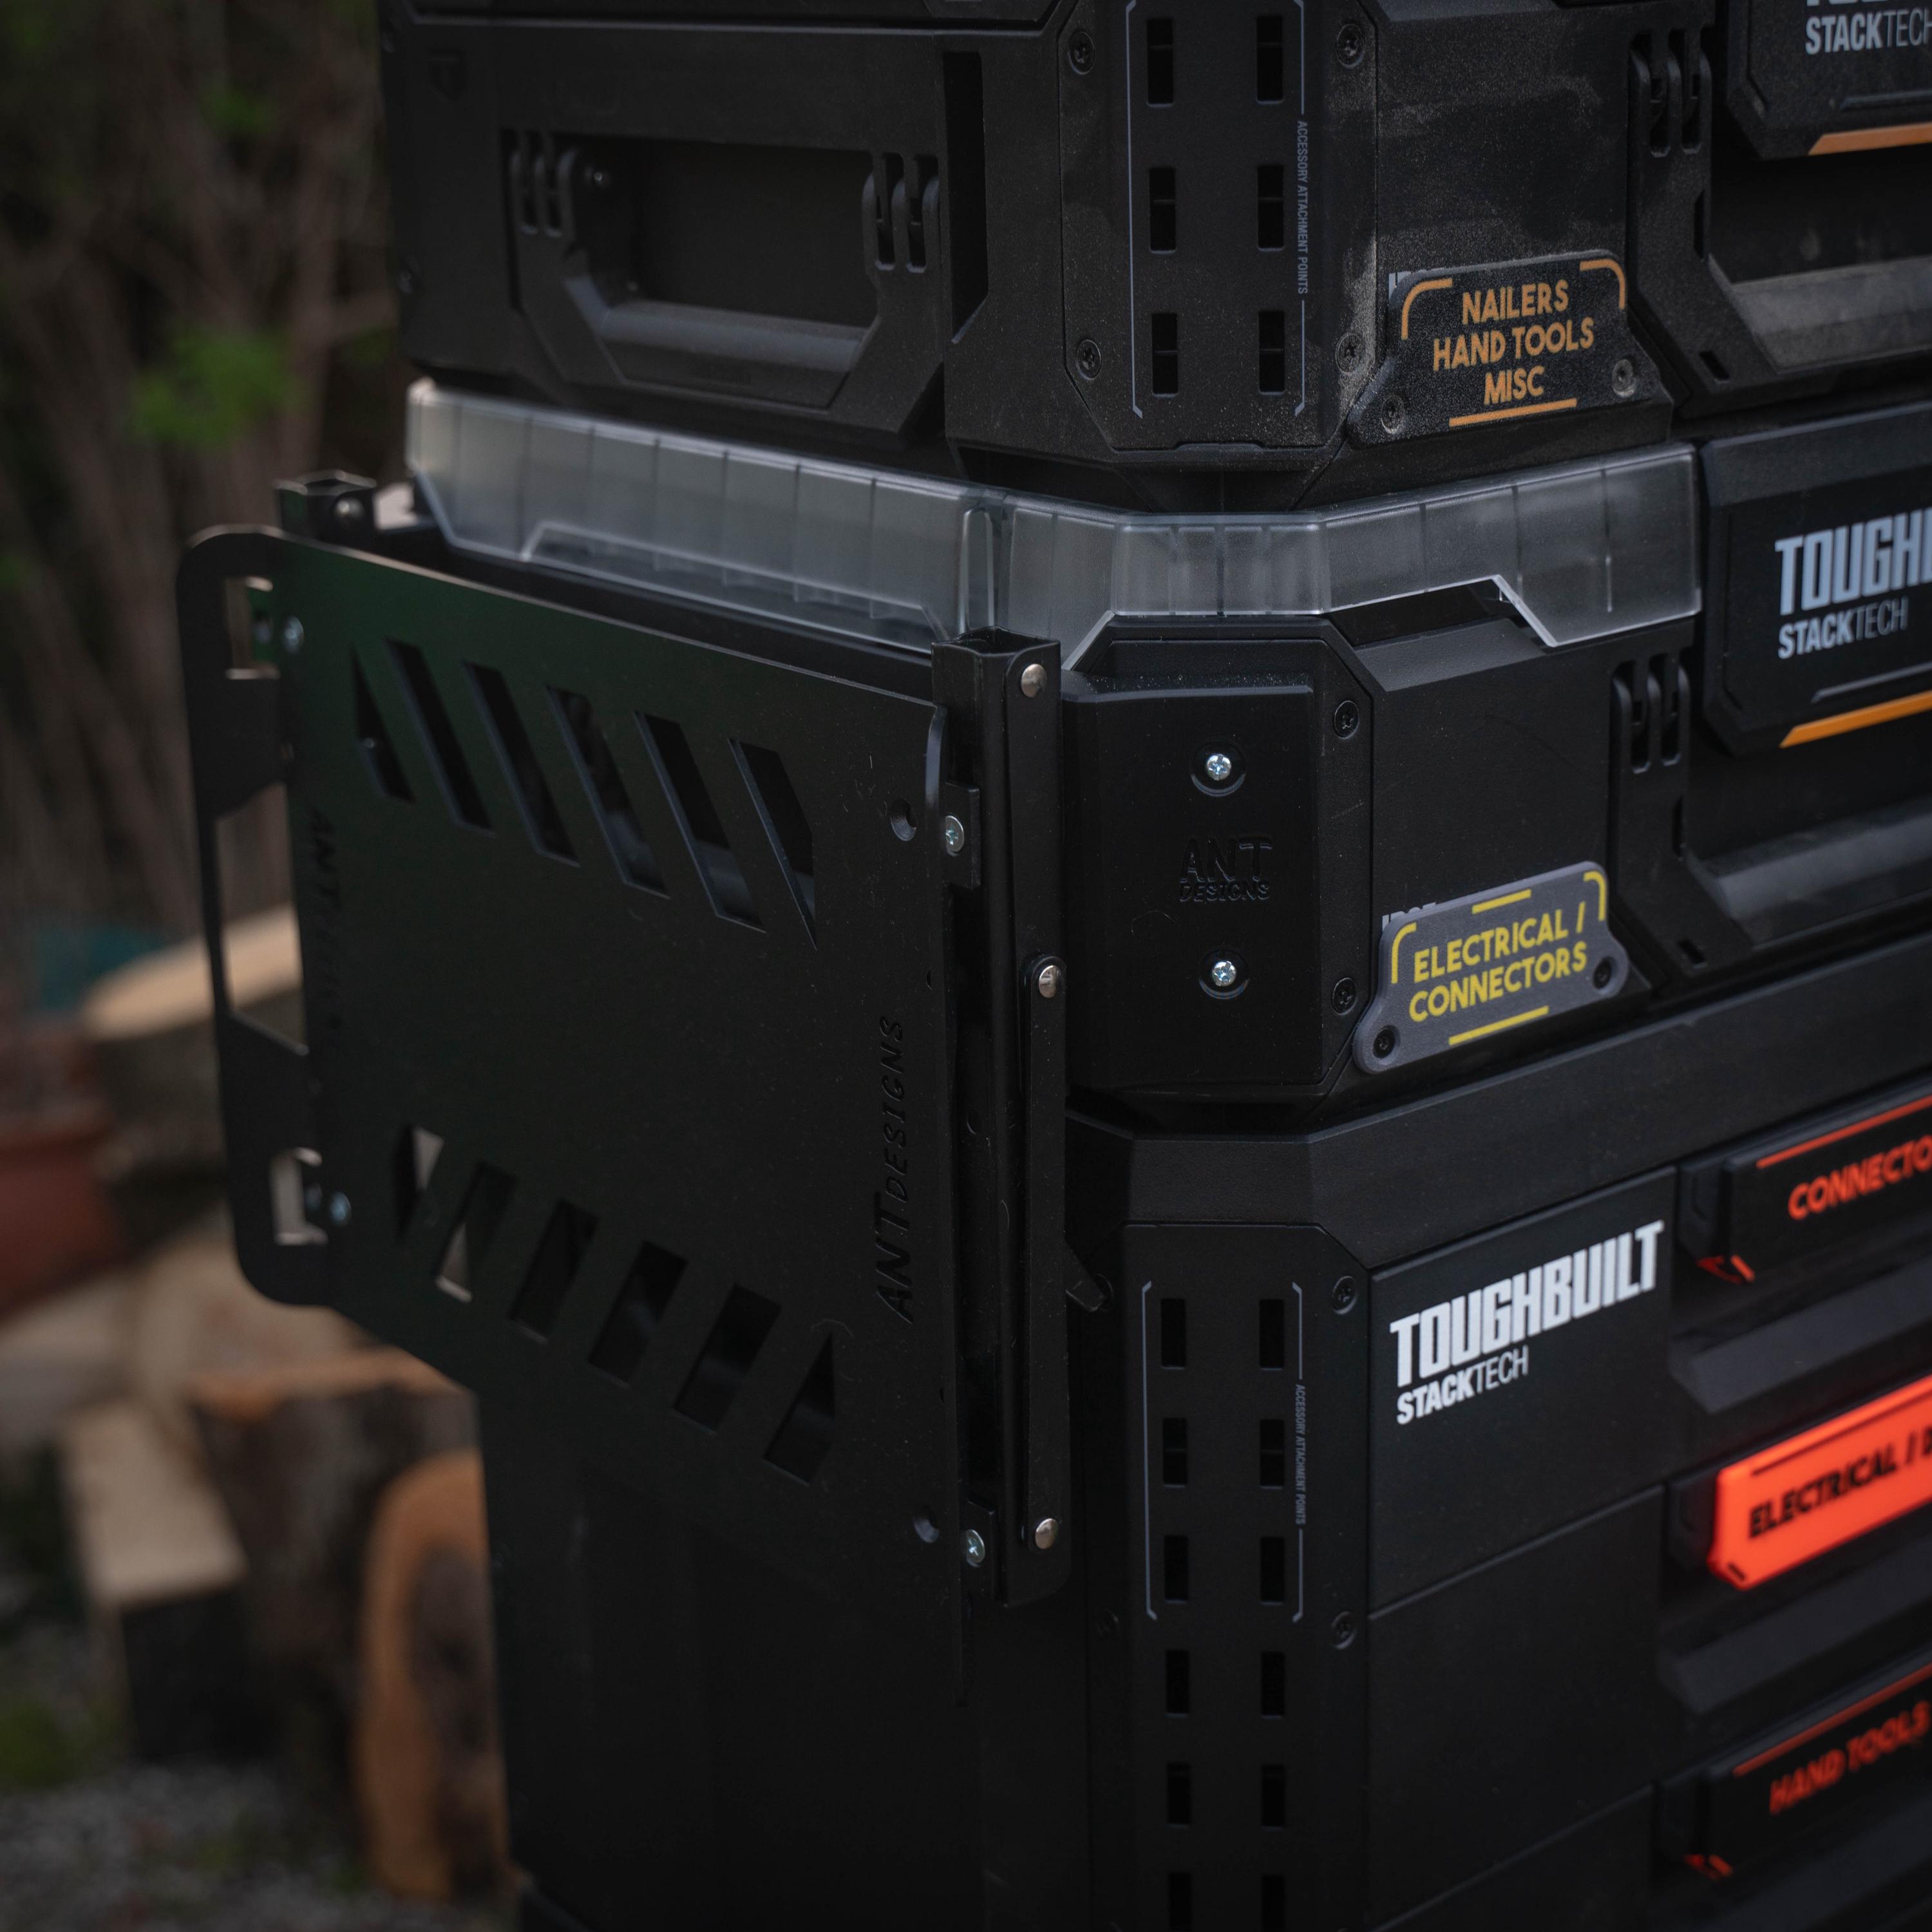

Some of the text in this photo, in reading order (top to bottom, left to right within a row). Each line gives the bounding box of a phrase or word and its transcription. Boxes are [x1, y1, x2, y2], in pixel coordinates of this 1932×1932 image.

[1805, 7, 1932, 55] STACKTECH
[1297, 120, 1308, 294] ACCESSORY ATTACHMENT POINTS
[1462, 279, 1569, 325] NAILERS
[1433, 316, 1595, 371] HAND TOOLS
[1483, 365, 1546, 406] MISC
[1777, 595, 1909, 659] STACKTECH
[1180, 837, 1273, 883] ANT
[1180, 880, 1270, 902] DESIGNS
[1408, 940, 1587, 1023] CONNECTORS
[1414, 909, 1568, 983] ELECTRICAL
[1576, 900, 1586, 934] /
[1389, 1220, 1665, 1388] TOUGHBUILT
[1396, 1345, 1530, 1425] STACKTECH
[1295, 1384, 1306, 1526] ACCESSORY ATTACHMENT POINTS
[1749, 1442, 1897, 1539] ELECTRICAL
[1769, 1700, 1931, 1815] HAND TOOLS
